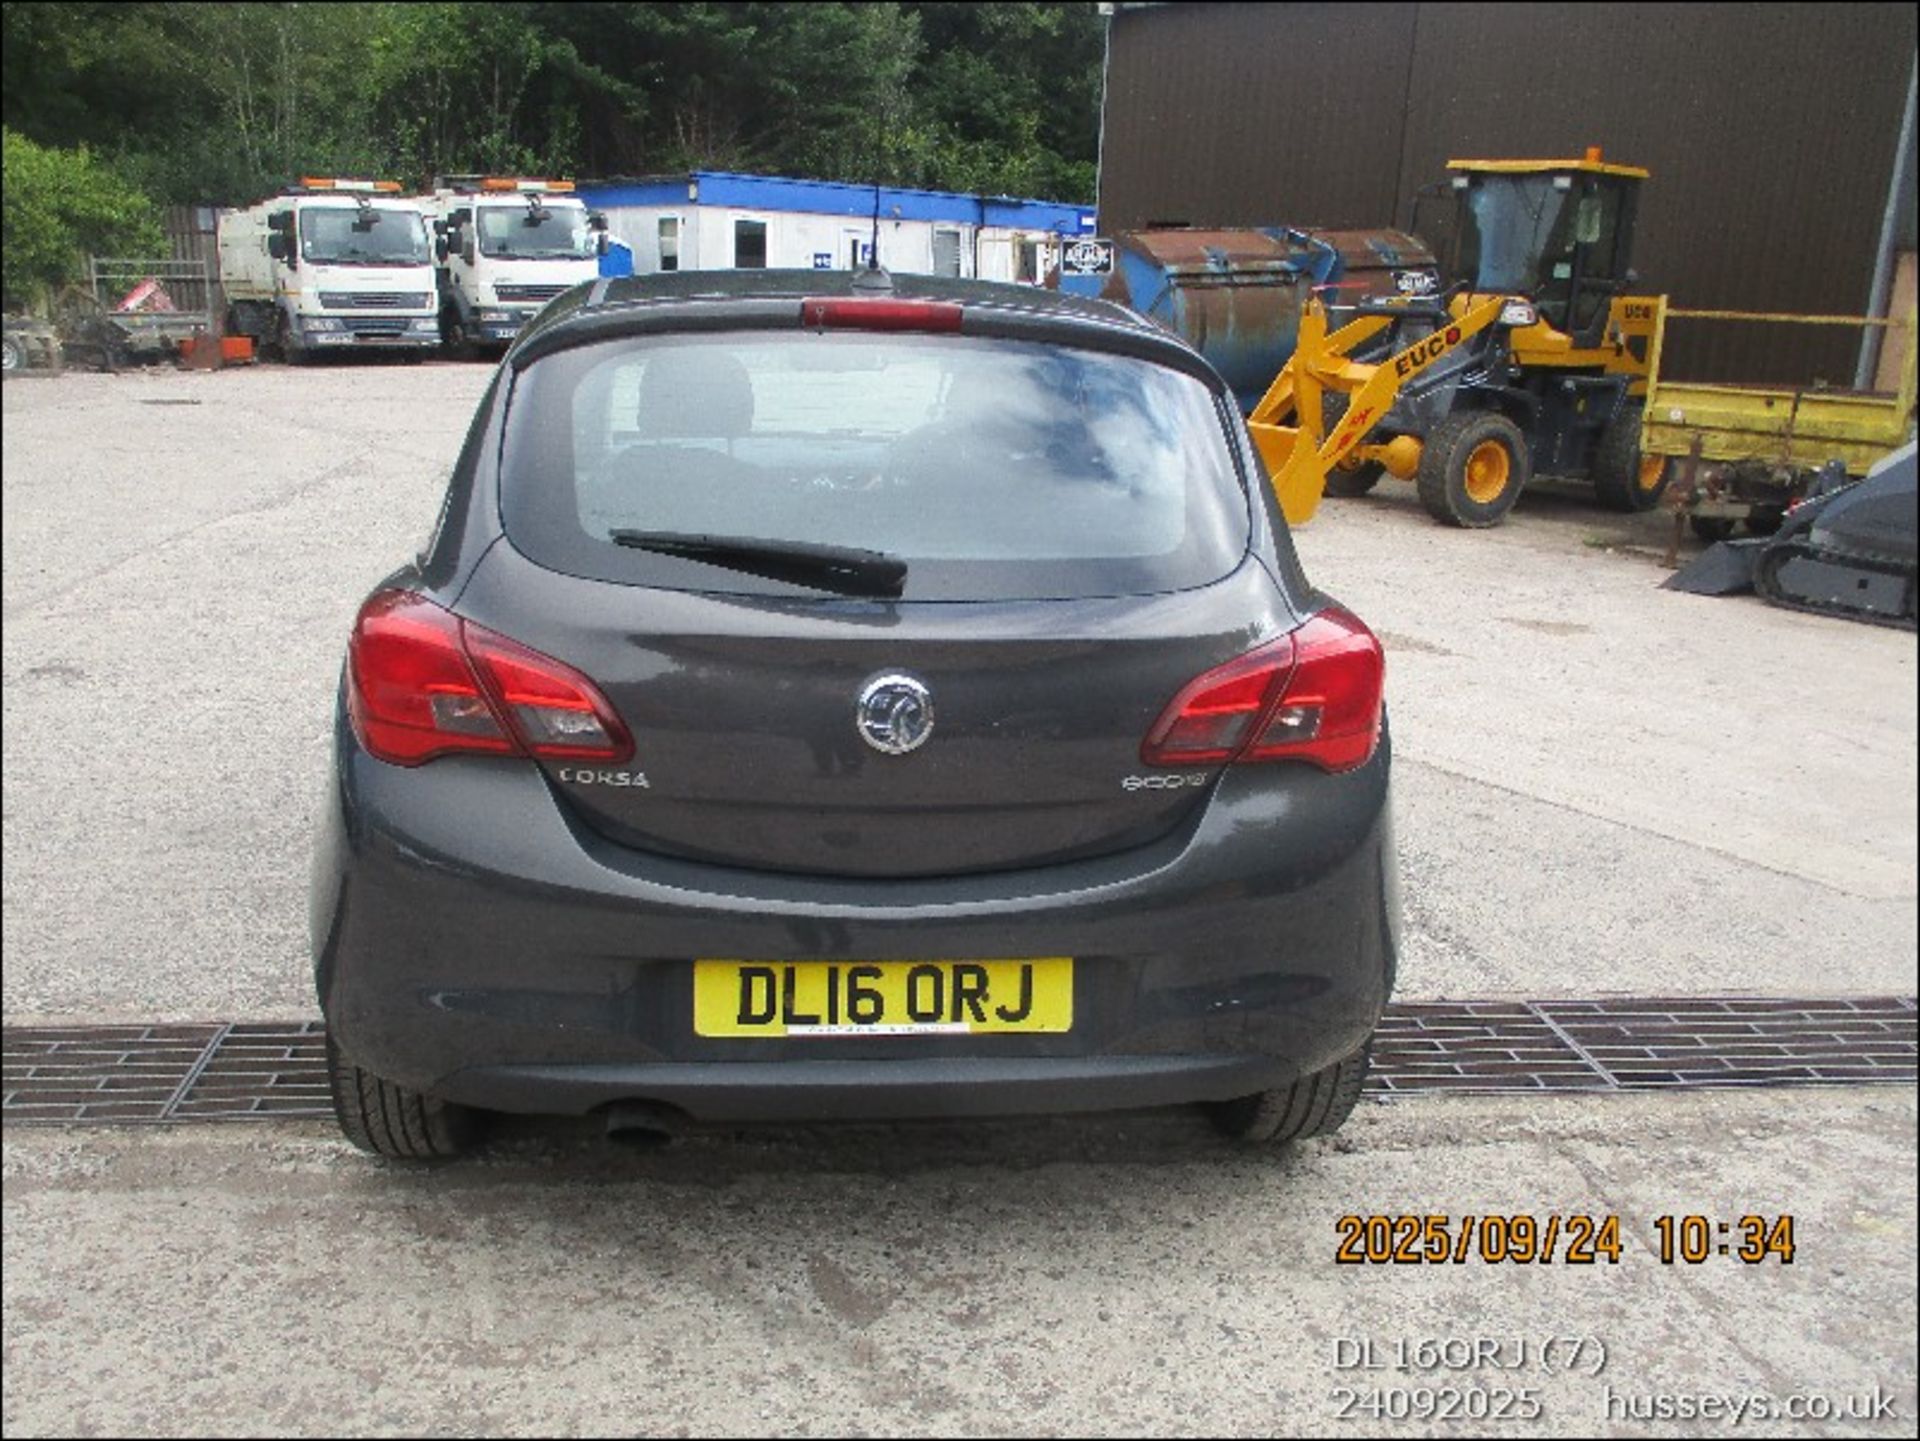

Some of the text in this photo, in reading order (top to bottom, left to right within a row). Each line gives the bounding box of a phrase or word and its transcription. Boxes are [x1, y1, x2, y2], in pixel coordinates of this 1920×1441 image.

[1395, 327, 1461, 378] EUCO
[560, 767, 650, 789] CORSA
[737, 963, 1033, 1026] DL16 ORJ
